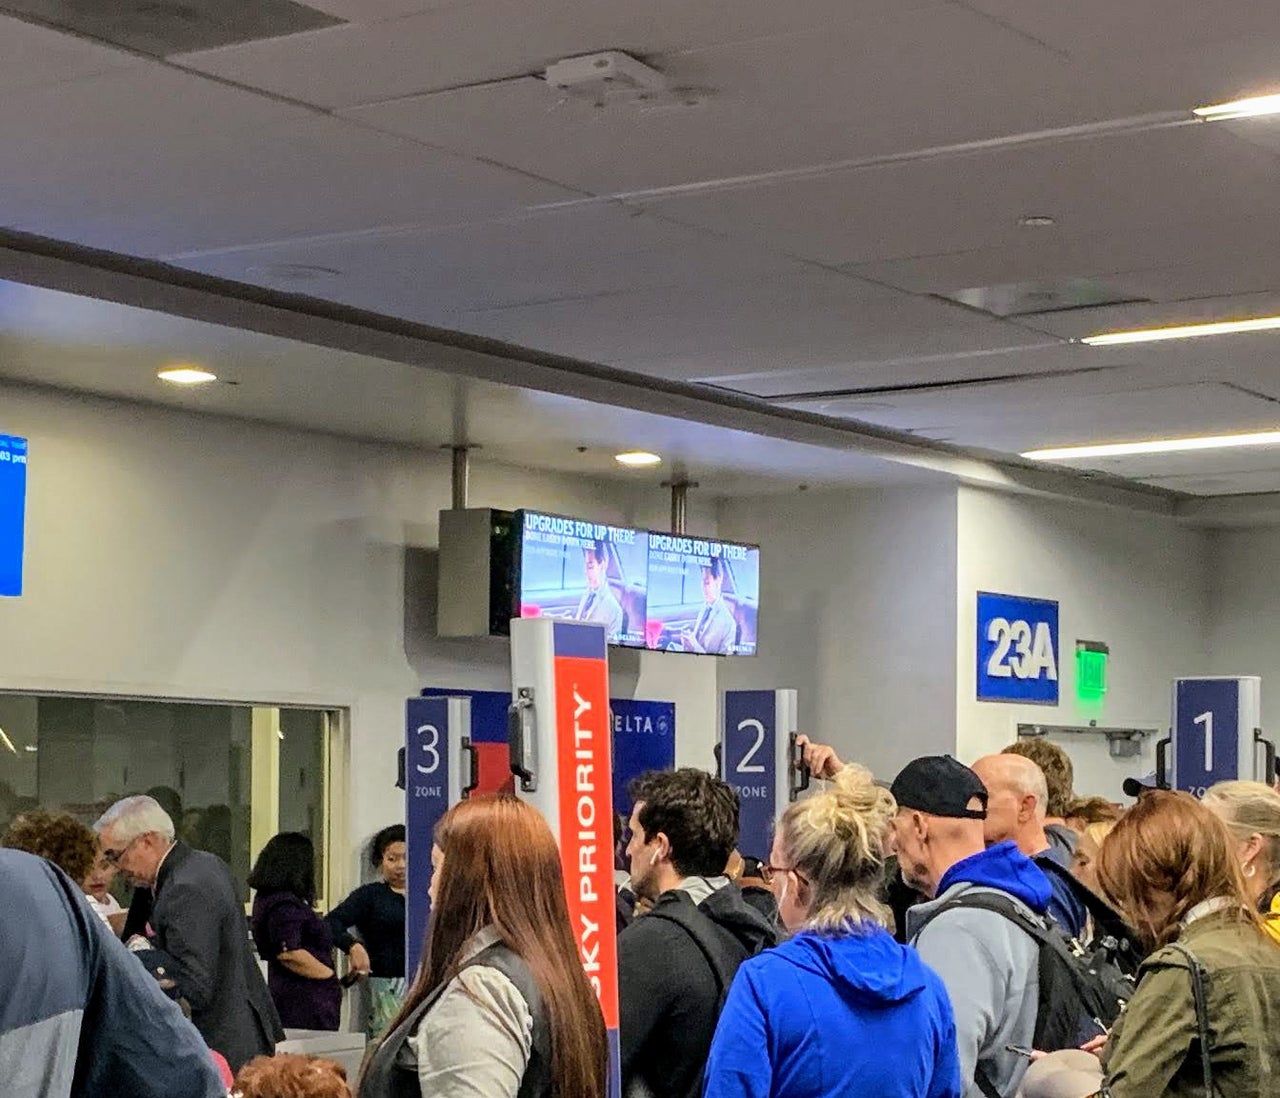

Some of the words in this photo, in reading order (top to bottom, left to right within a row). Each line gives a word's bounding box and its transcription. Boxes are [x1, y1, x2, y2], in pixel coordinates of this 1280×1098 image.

[12, 454, 26, 464] pm
[525, 513, 574, 537] UPGRADES
[575, 521, 593, 539] FOR
[594, 524, 607, 541] UP
[607, 526, 635, 545] THERE
[649, 535, 692, 554] UPGRADES
[693, 540, 709, 556] FOR
[710, 543, 721, 558] UP
[722, 544, 747, 560] THERE
[987, 617, 1058, 681] 23A
[614, 714, 653, 733] ELTA
[416, 724, 440, 773] 3
[736, 719, 765, 772] 2
[1193, 711, 1213, 772] 1
[415, 785, 442, 798] ZONE
[573, 690, 599, 902] PRIORITY
[1188, 786, 1208, 798] ZO
